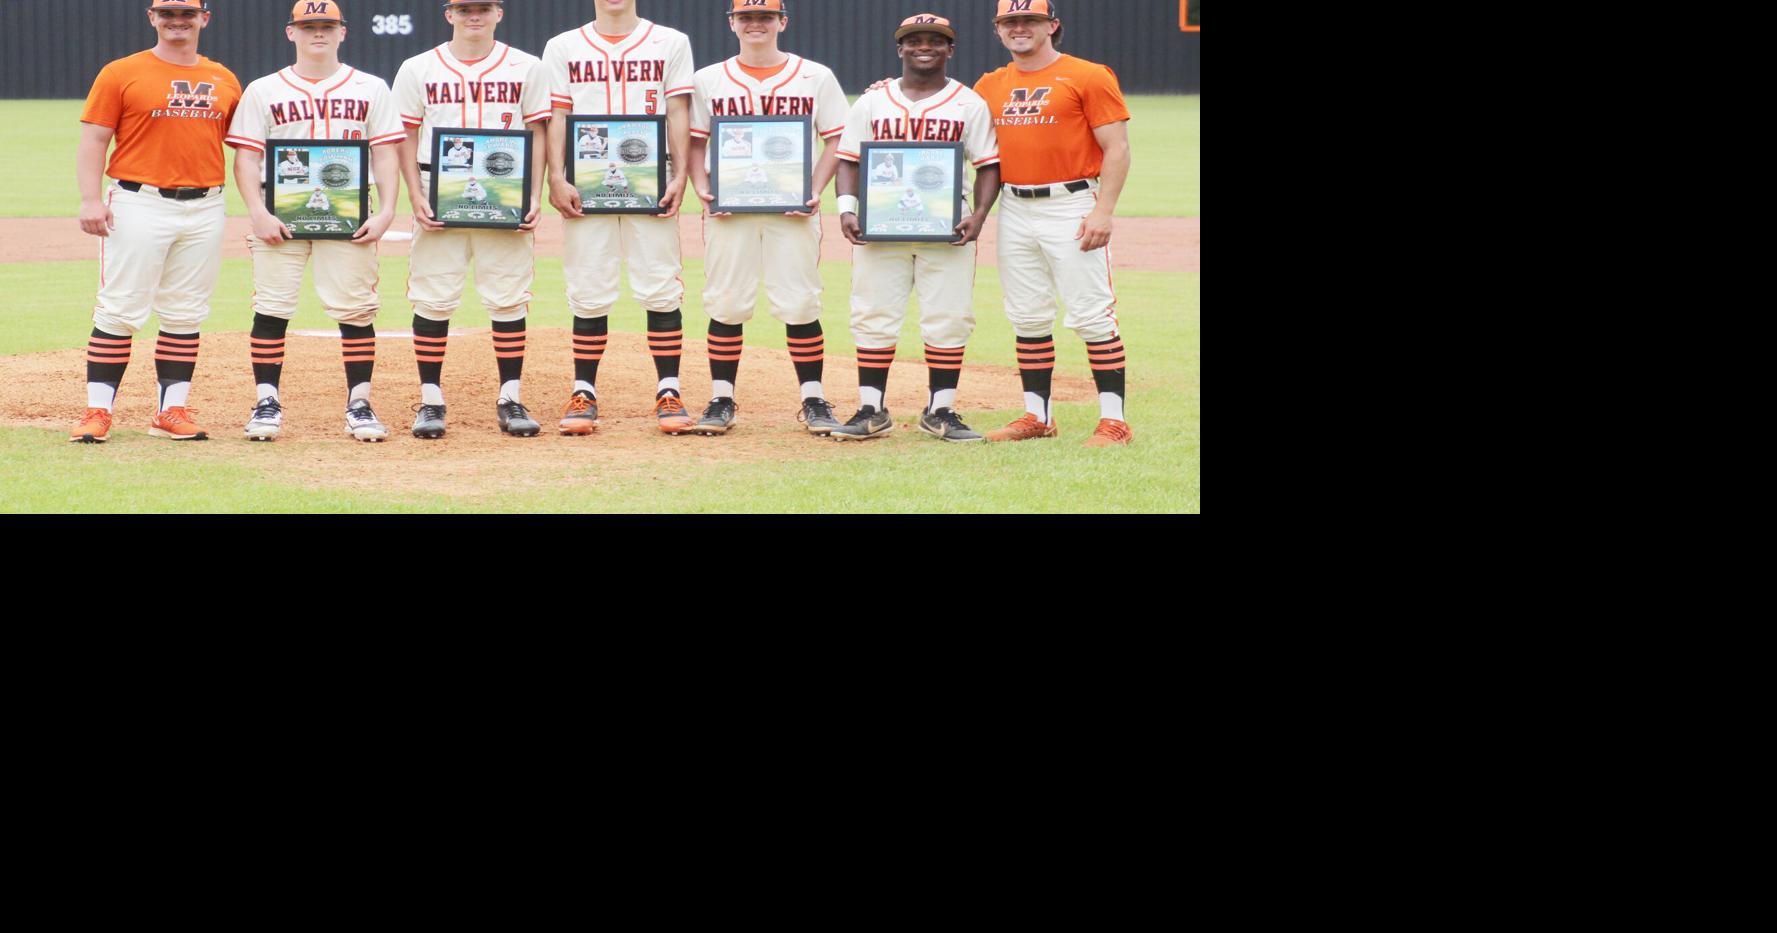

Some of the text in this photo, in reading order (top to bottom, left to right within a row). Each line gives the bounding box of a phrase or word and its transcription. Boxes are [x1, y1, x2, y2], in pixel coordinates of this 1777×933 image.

[303, 2, 329, 15] M
[1007, 0, 1032, 13] M
[371, 14, 413, 35] 385
[568, 60, 665, 84] MALVERN
[166, 93, 219, 101] LEOPARDS
[171, 80, 215, 110] M
[425, 81, 523, 105] MALVERN
[645, 89, 658, 115] 5
[1002, 87, 1052, 116] M
[1002, 99, 1050, 108] LEOPARDS
[151, 108, 223, 120] BASEBALL
[270, 98, 370, 126] MALVERN
[711, 95, 814, 116] MALVERN
[870, 118, 965, 142] MALVERN
[993, 115, 1059, 126] BASEBALL
